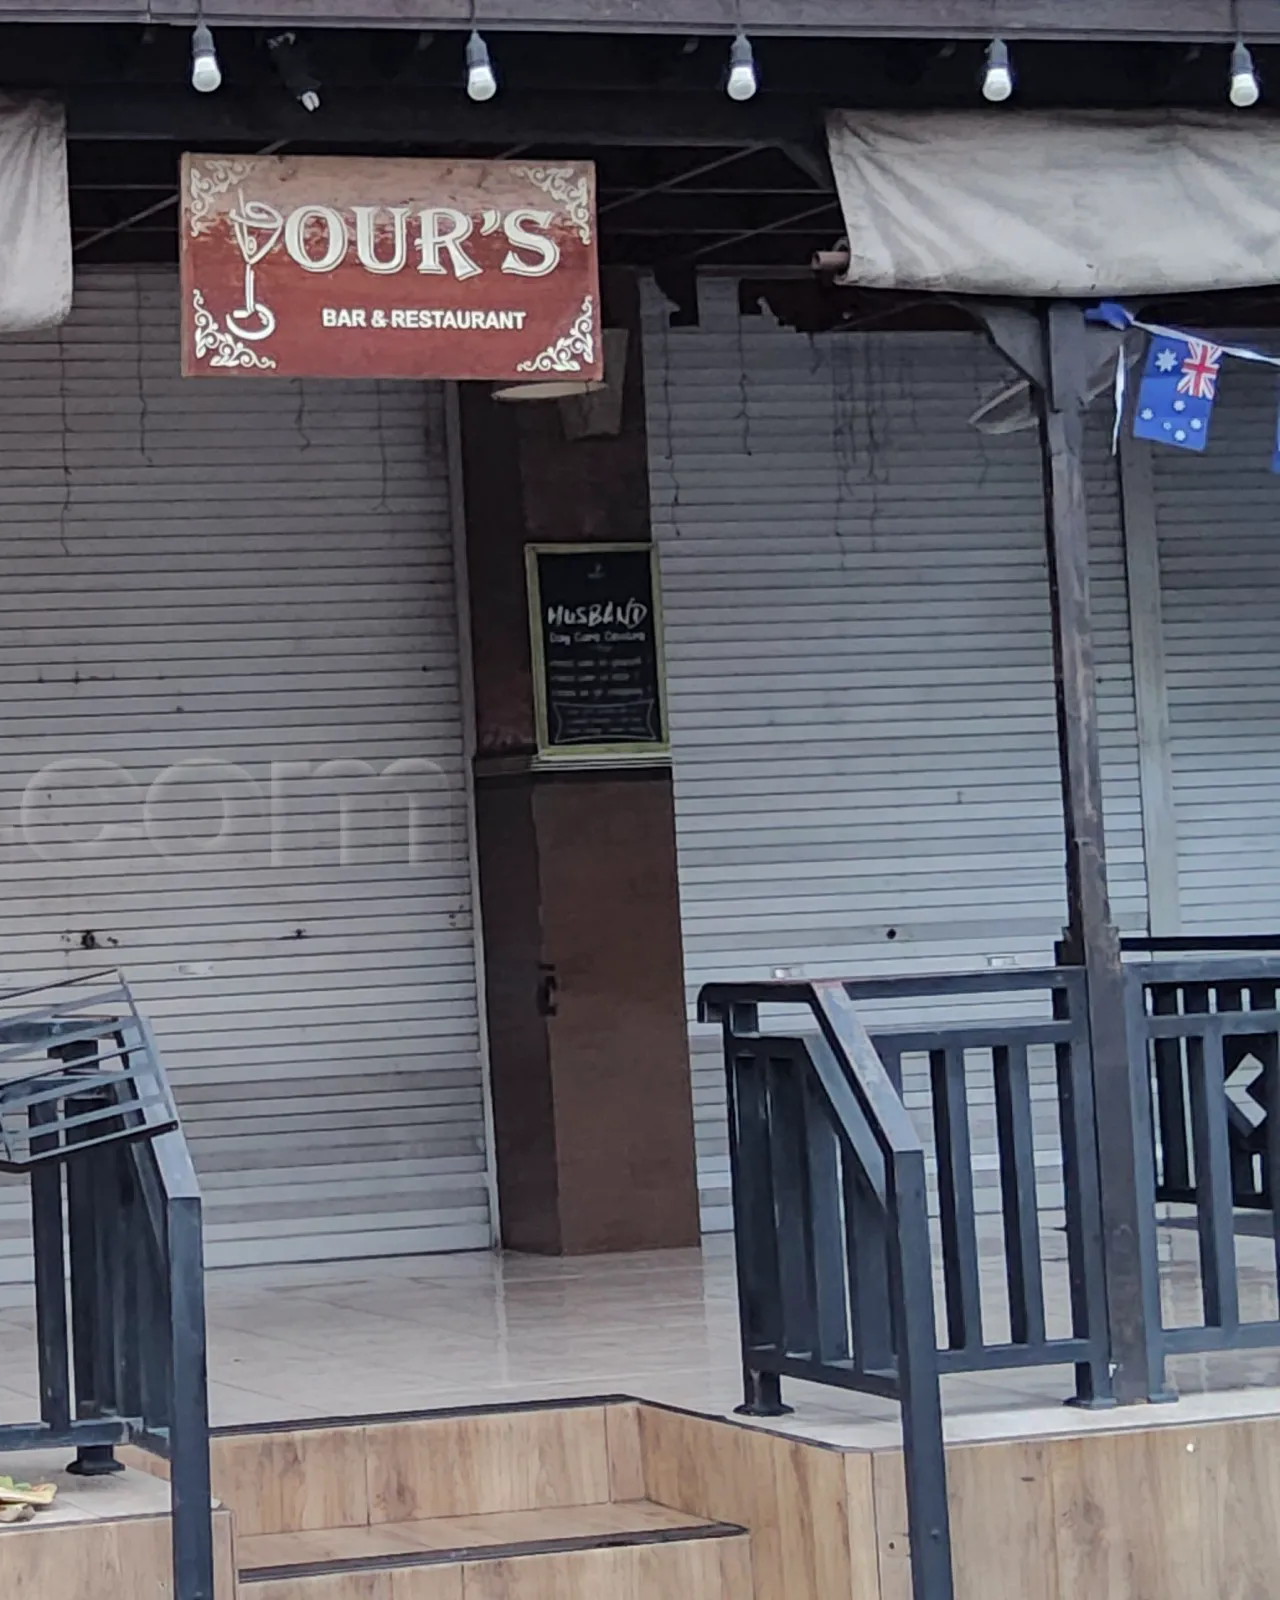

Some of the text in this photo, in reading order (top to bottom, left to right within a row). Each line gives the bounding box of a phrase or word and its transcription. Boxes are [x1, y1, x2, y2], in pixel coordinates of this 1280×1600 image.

[322, 308, 526, 329] BAR & RESTAURANT
